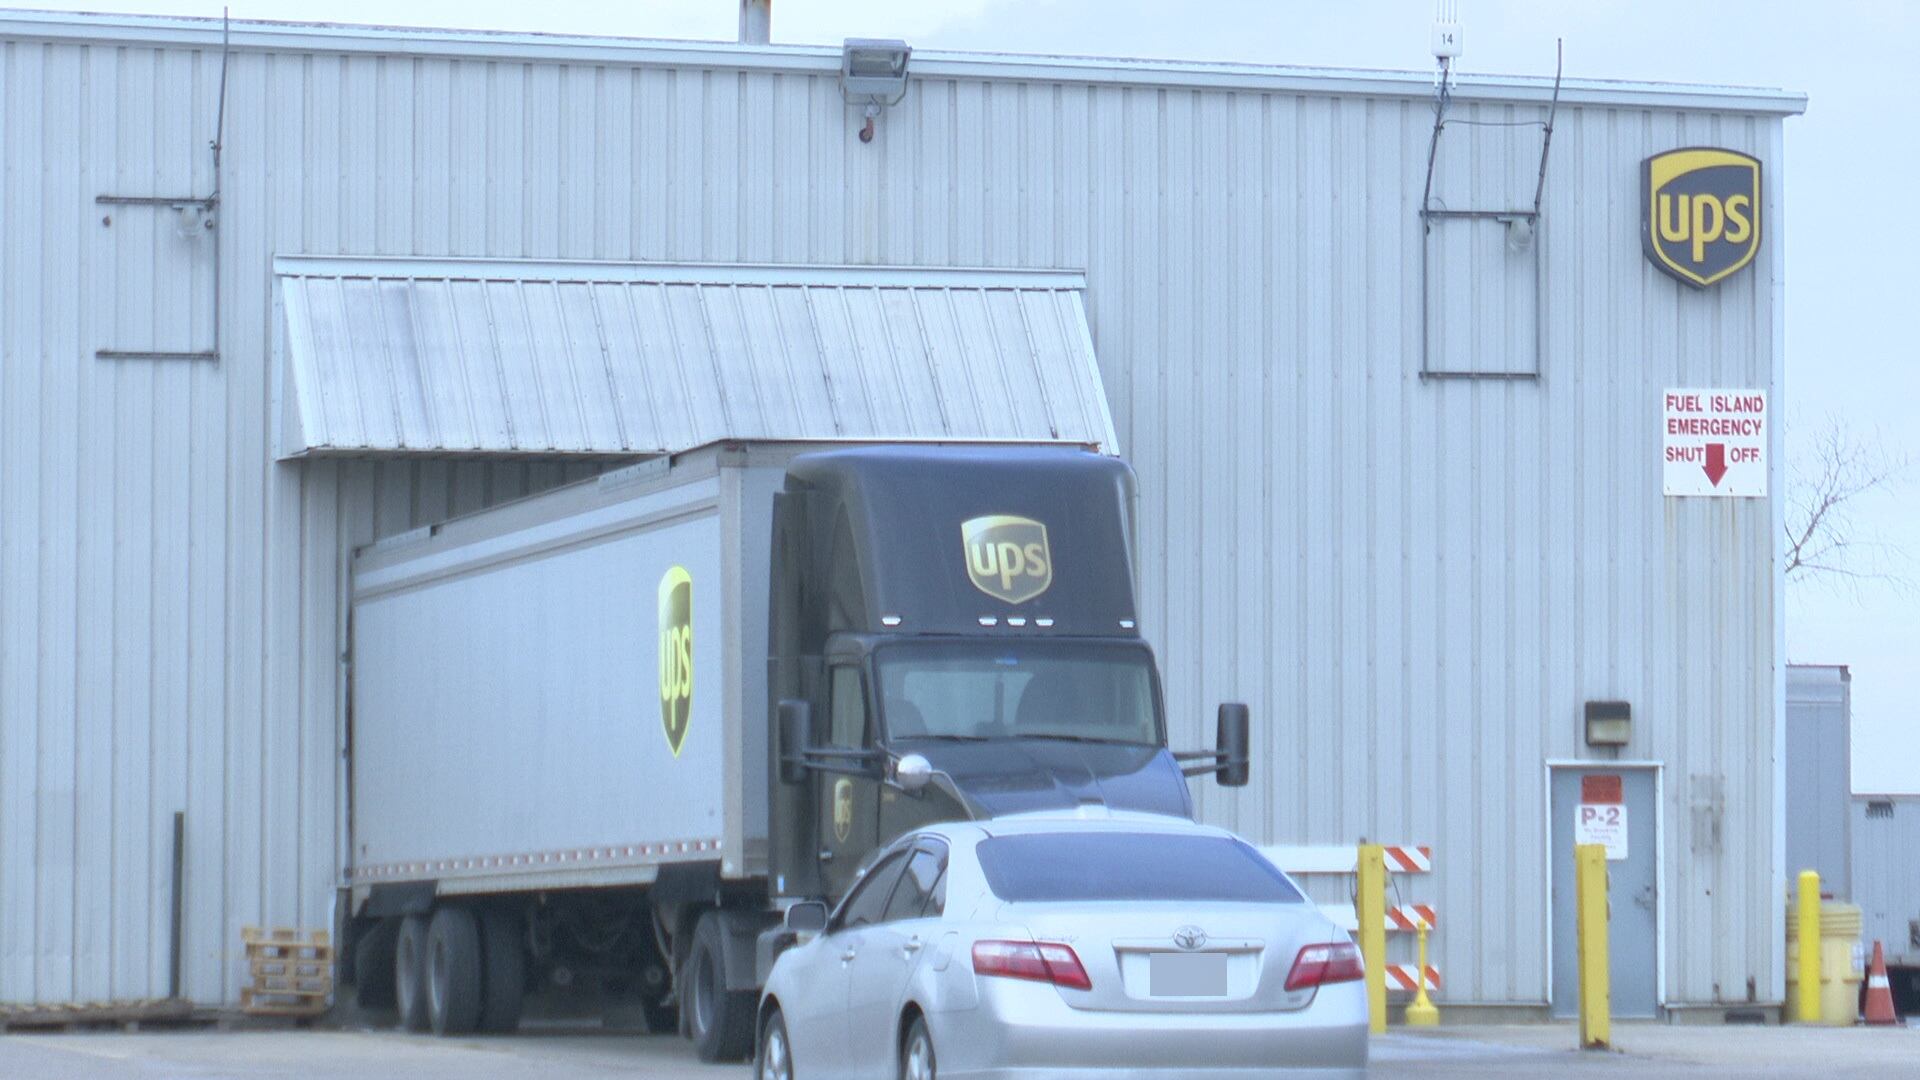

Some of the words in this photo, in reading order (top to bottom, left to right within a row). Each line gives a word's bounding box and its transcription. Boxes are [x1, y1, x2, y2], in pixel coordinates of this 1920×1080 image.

[1442, 33, 1453, 45] 14
[1659, 193, 1751, 262] ups
[1666, 394, 1703, 412] FUEL
[1710, 395, 1764, 413] ISLAND
[1667, 418, 1762, 436] EMERGENCY
[1665, 446, 1704, 462] SHUT
[971, 541, 1047, 590] ups
[661, 624, 691, 731] ups
[1581, 807, 1620, 826] P-2
